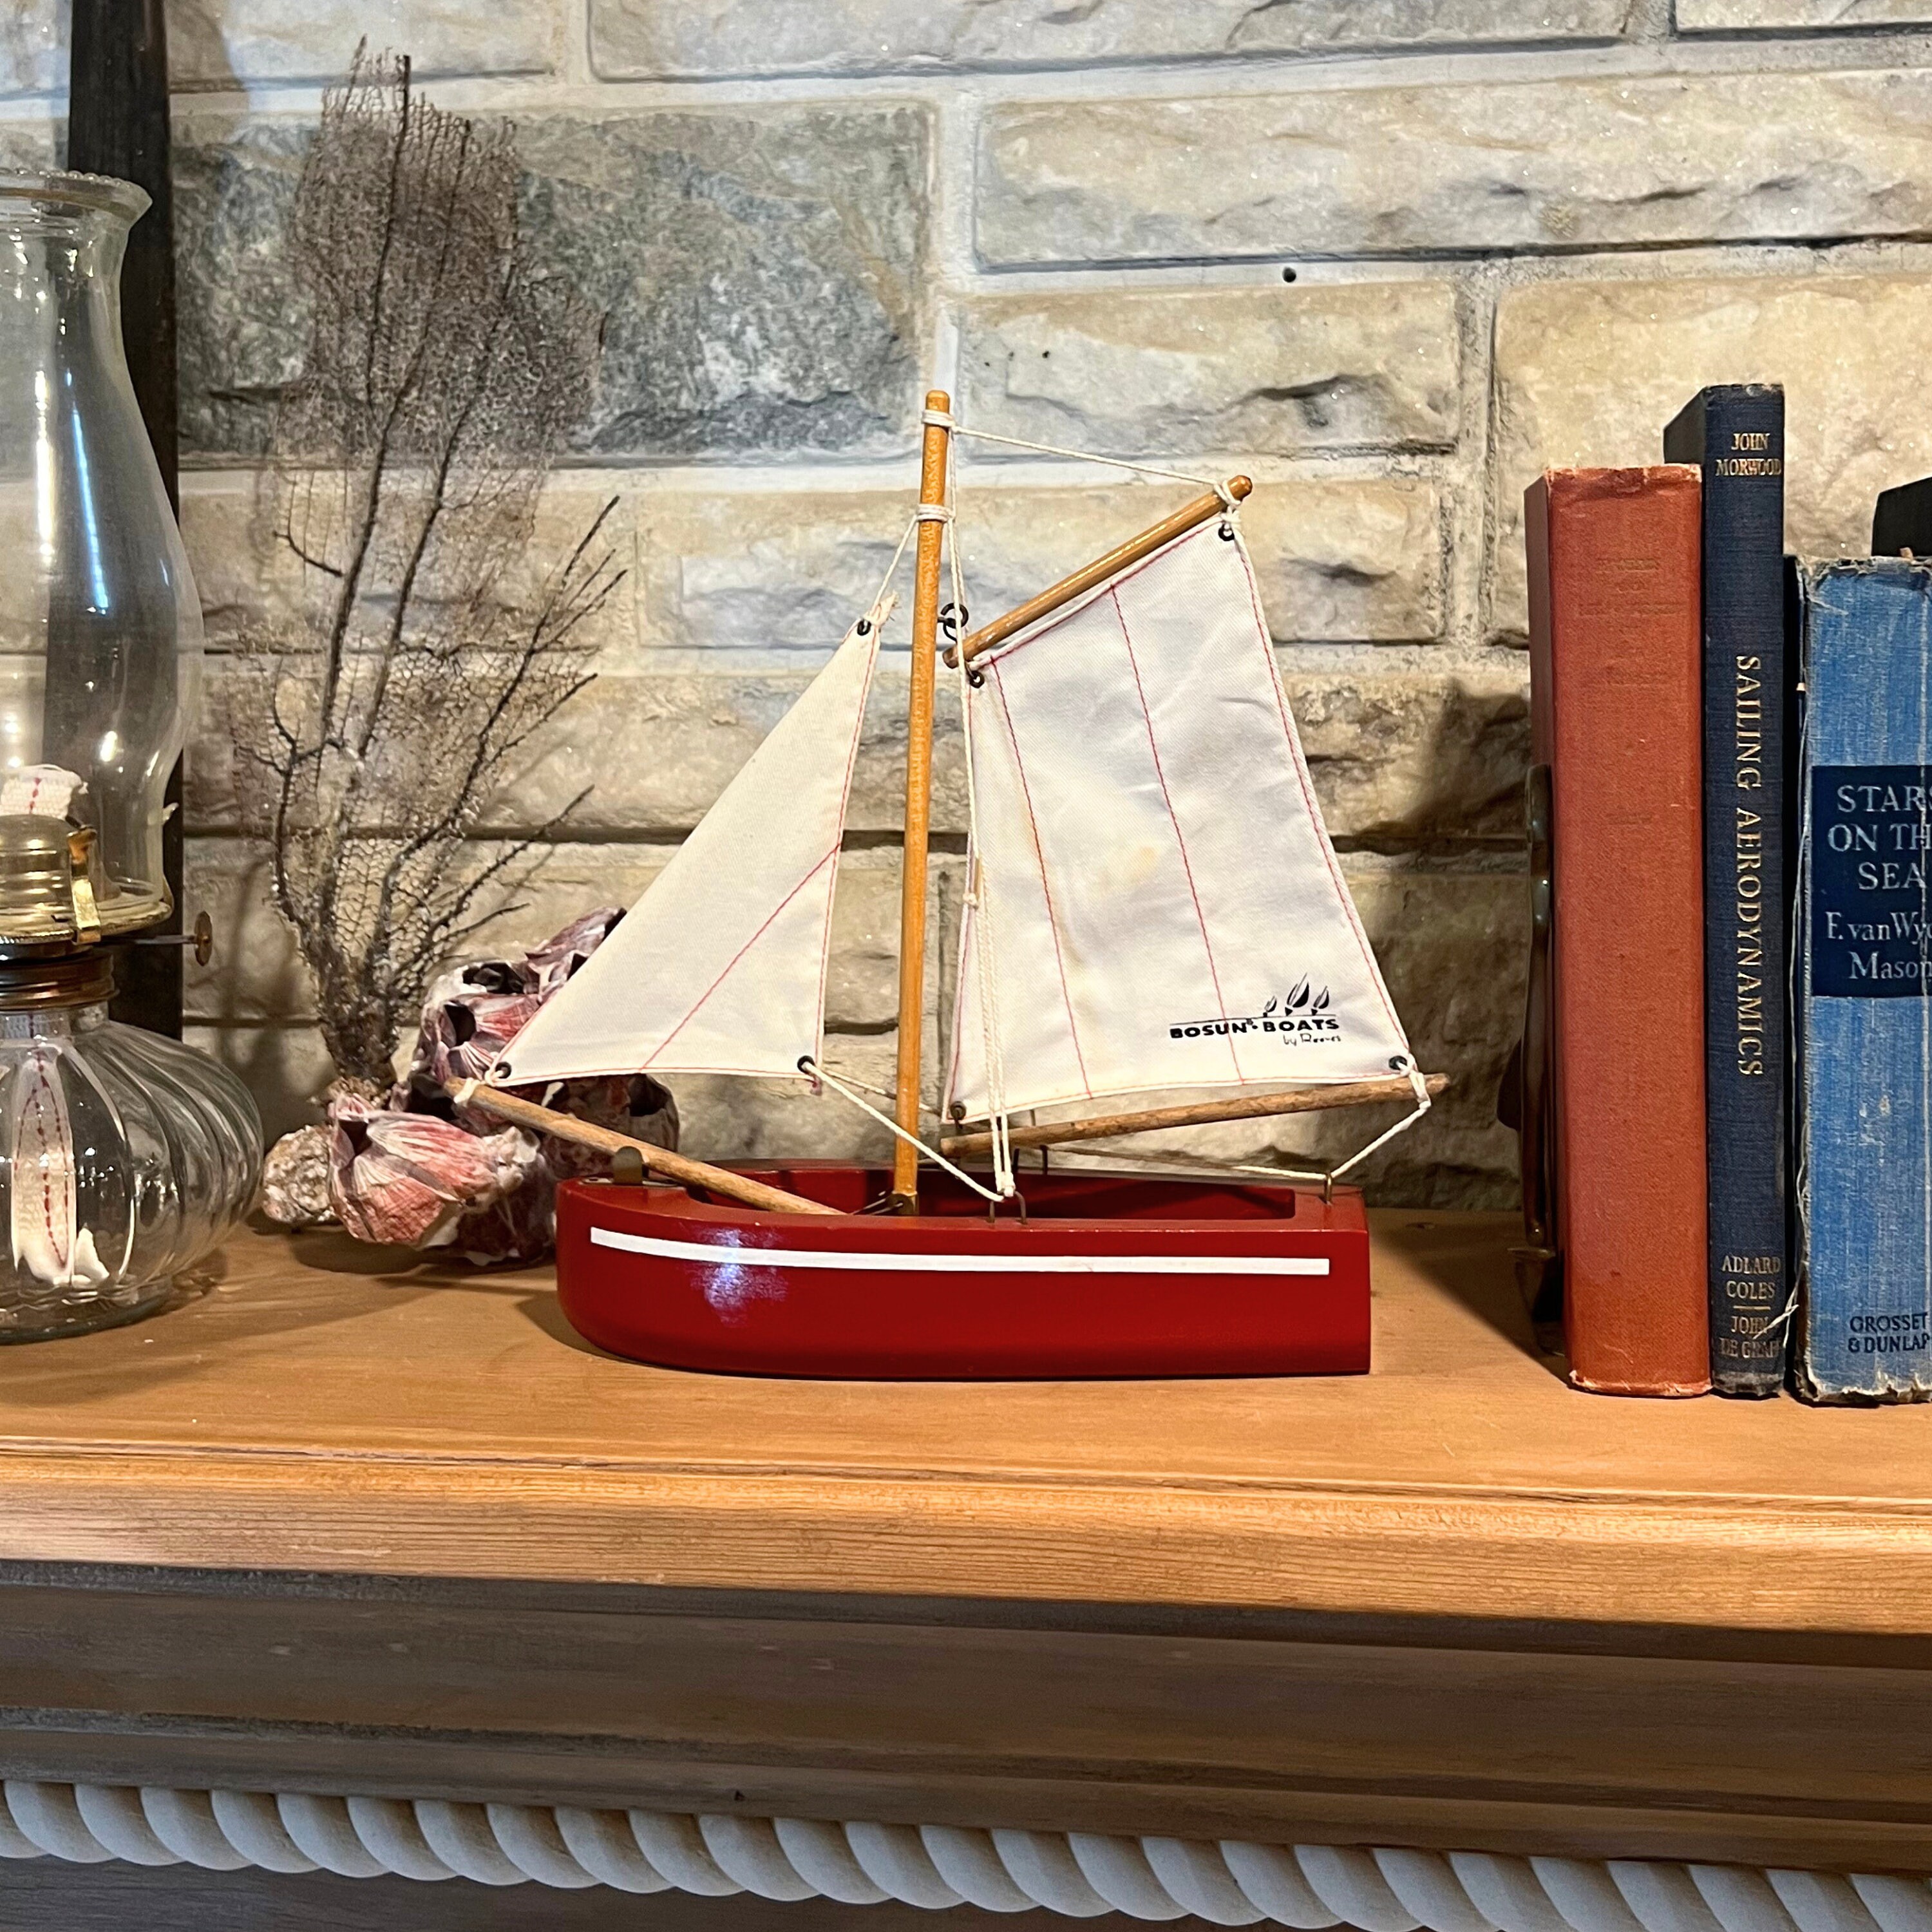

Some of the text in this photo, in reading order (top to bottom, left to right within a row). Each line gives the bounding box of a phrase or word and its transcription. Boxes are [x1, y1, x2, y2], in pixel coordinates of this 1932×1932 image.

[1730, 432, 1771, 451] JOHN
[1715, 458, 1782, 477] MORWOOD
[1837, 784, 1932, 813] STAR
[1827, 823, 1932, 852] ON TH
[1736, 656, 1763, 1075] SAILING AERODYNAMICS
[1858, 862, 1927, 891] SEA
[1848, 951, 1932, 980] Mason
[1263, 1019, 1340, 1032] BOATS
[1721, 1255, 1782, 1274] ADLARD
[1726, 1280, 1776, 1300] COLES
[1730, 1316, 1769, 1334] JOHN
[1850, 1312, 1928, 1334] GROSSET
[1864, 1332, 1930, 1353] DUNLAP
